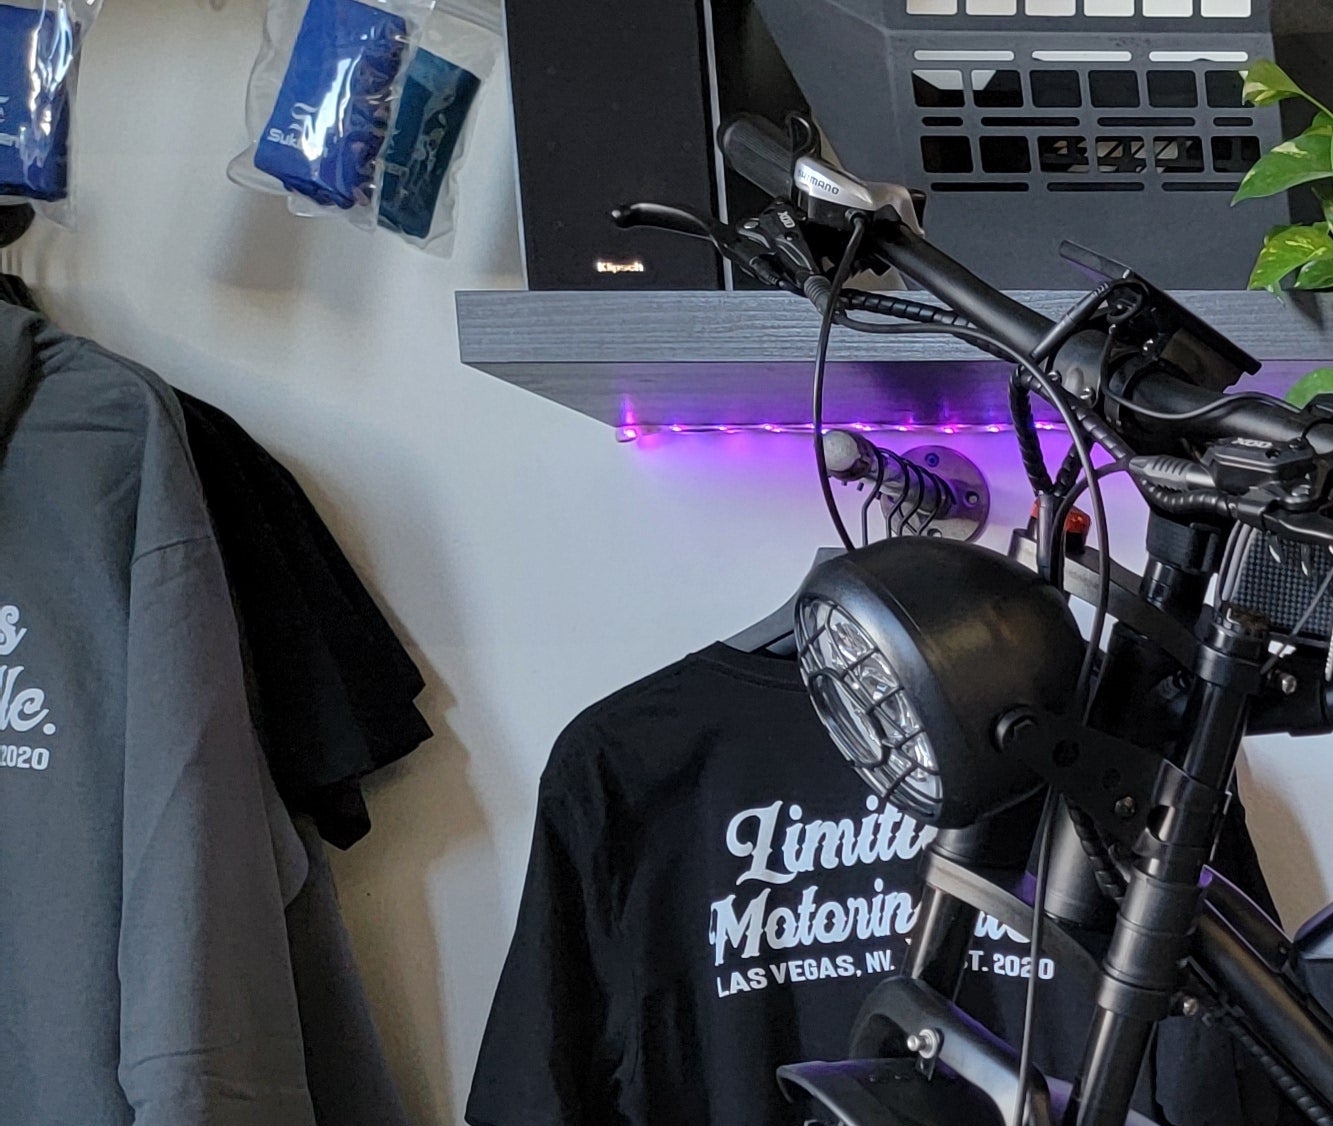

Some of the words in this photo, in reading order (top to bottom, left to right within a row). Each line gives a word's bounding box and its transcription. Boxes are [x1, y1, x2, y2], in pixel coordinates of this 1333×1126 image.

[597, 261, 645, 274] Klipsch
[709, 878, 923, 967] Motorin
[717, 968, 768, 998] LAS
[770, 955, 862, 985] VEGAS,
[865, 950, 896, 974] NV.
